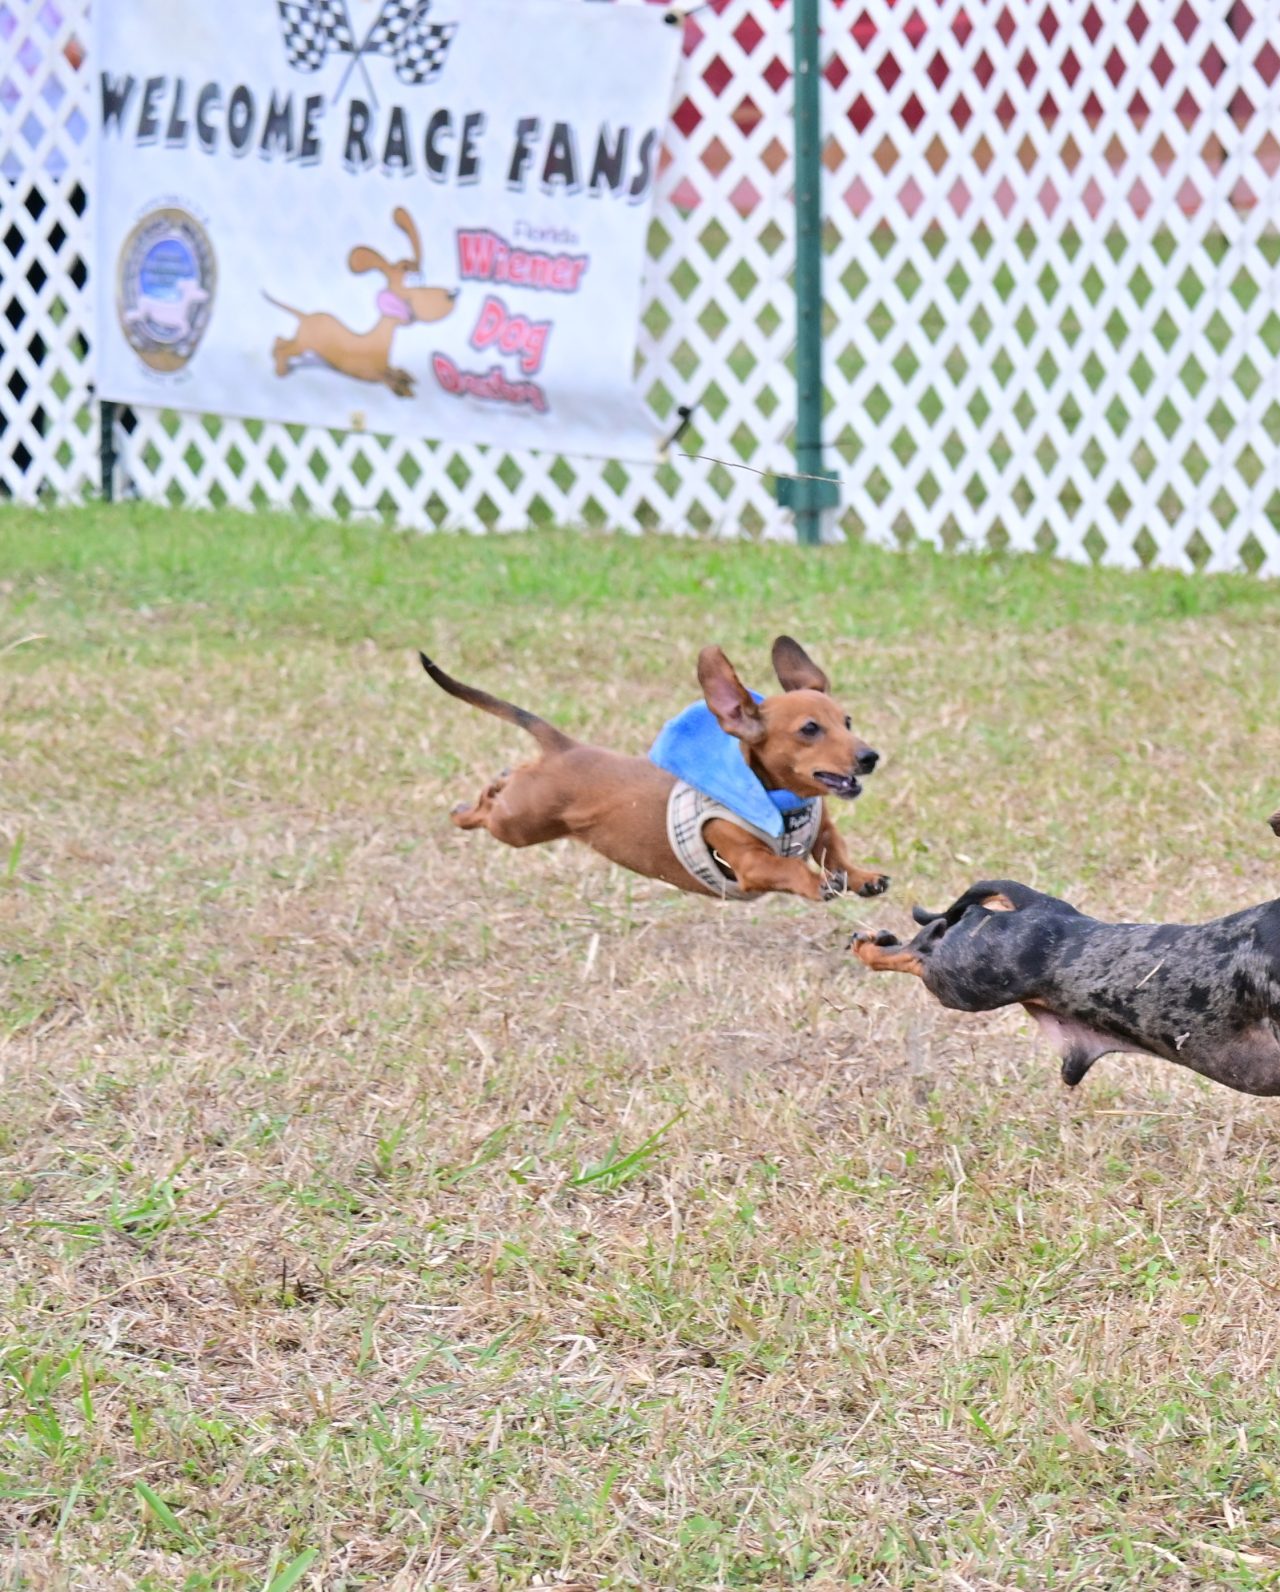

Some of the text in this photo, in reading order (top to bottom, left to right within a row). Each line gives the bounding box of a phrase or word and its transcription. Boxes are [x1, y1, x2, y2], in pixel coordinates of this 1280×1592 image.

[101, 71, 657, 204] WELCOME RACE FANS
[457, 226, 590, 294] Wiener
[513, 219, 579, 246] Florida
[469, 295, 553, 376] Dog
